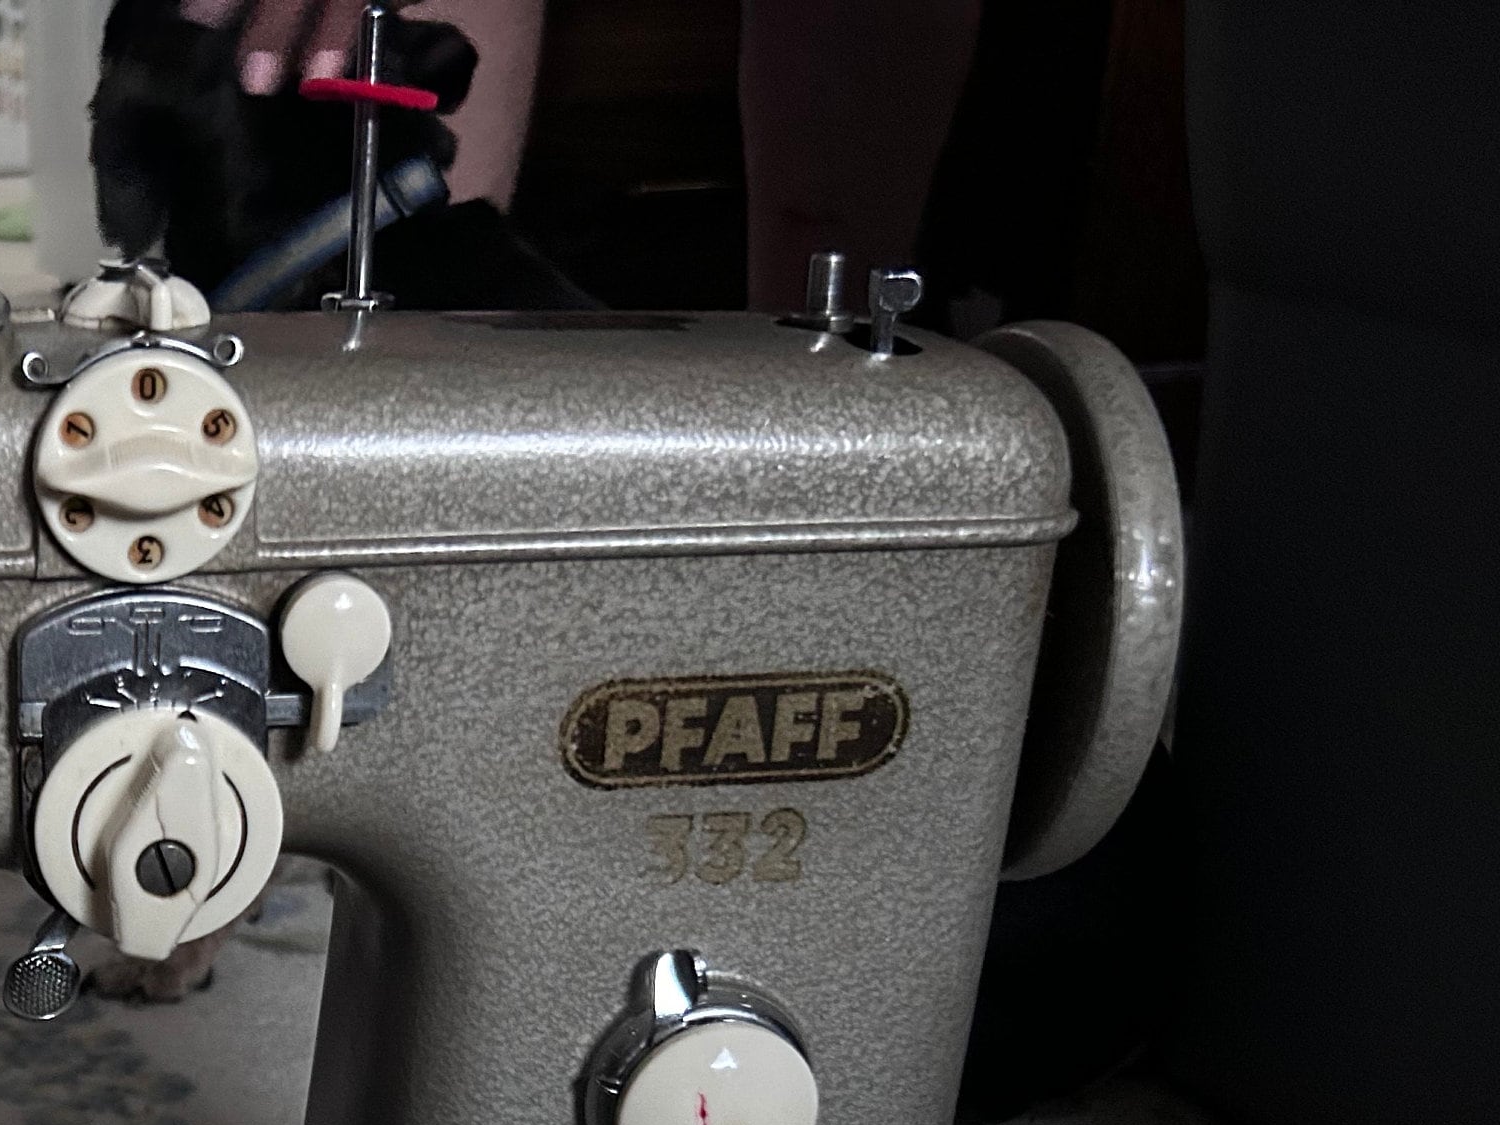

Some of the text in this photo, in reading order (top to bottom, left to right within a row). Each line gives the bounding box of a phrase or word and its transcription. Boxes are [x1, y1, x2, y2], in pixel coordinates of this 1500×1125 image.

[138, 375, 158, 402] 0
[65, 420, 91, 440] 1
[202, 411, 231, 438] 5
[135, 539, 155, 565] 3
[603, 690, 866, 772] PFAFF
[648, 806, 807, 885] 332
